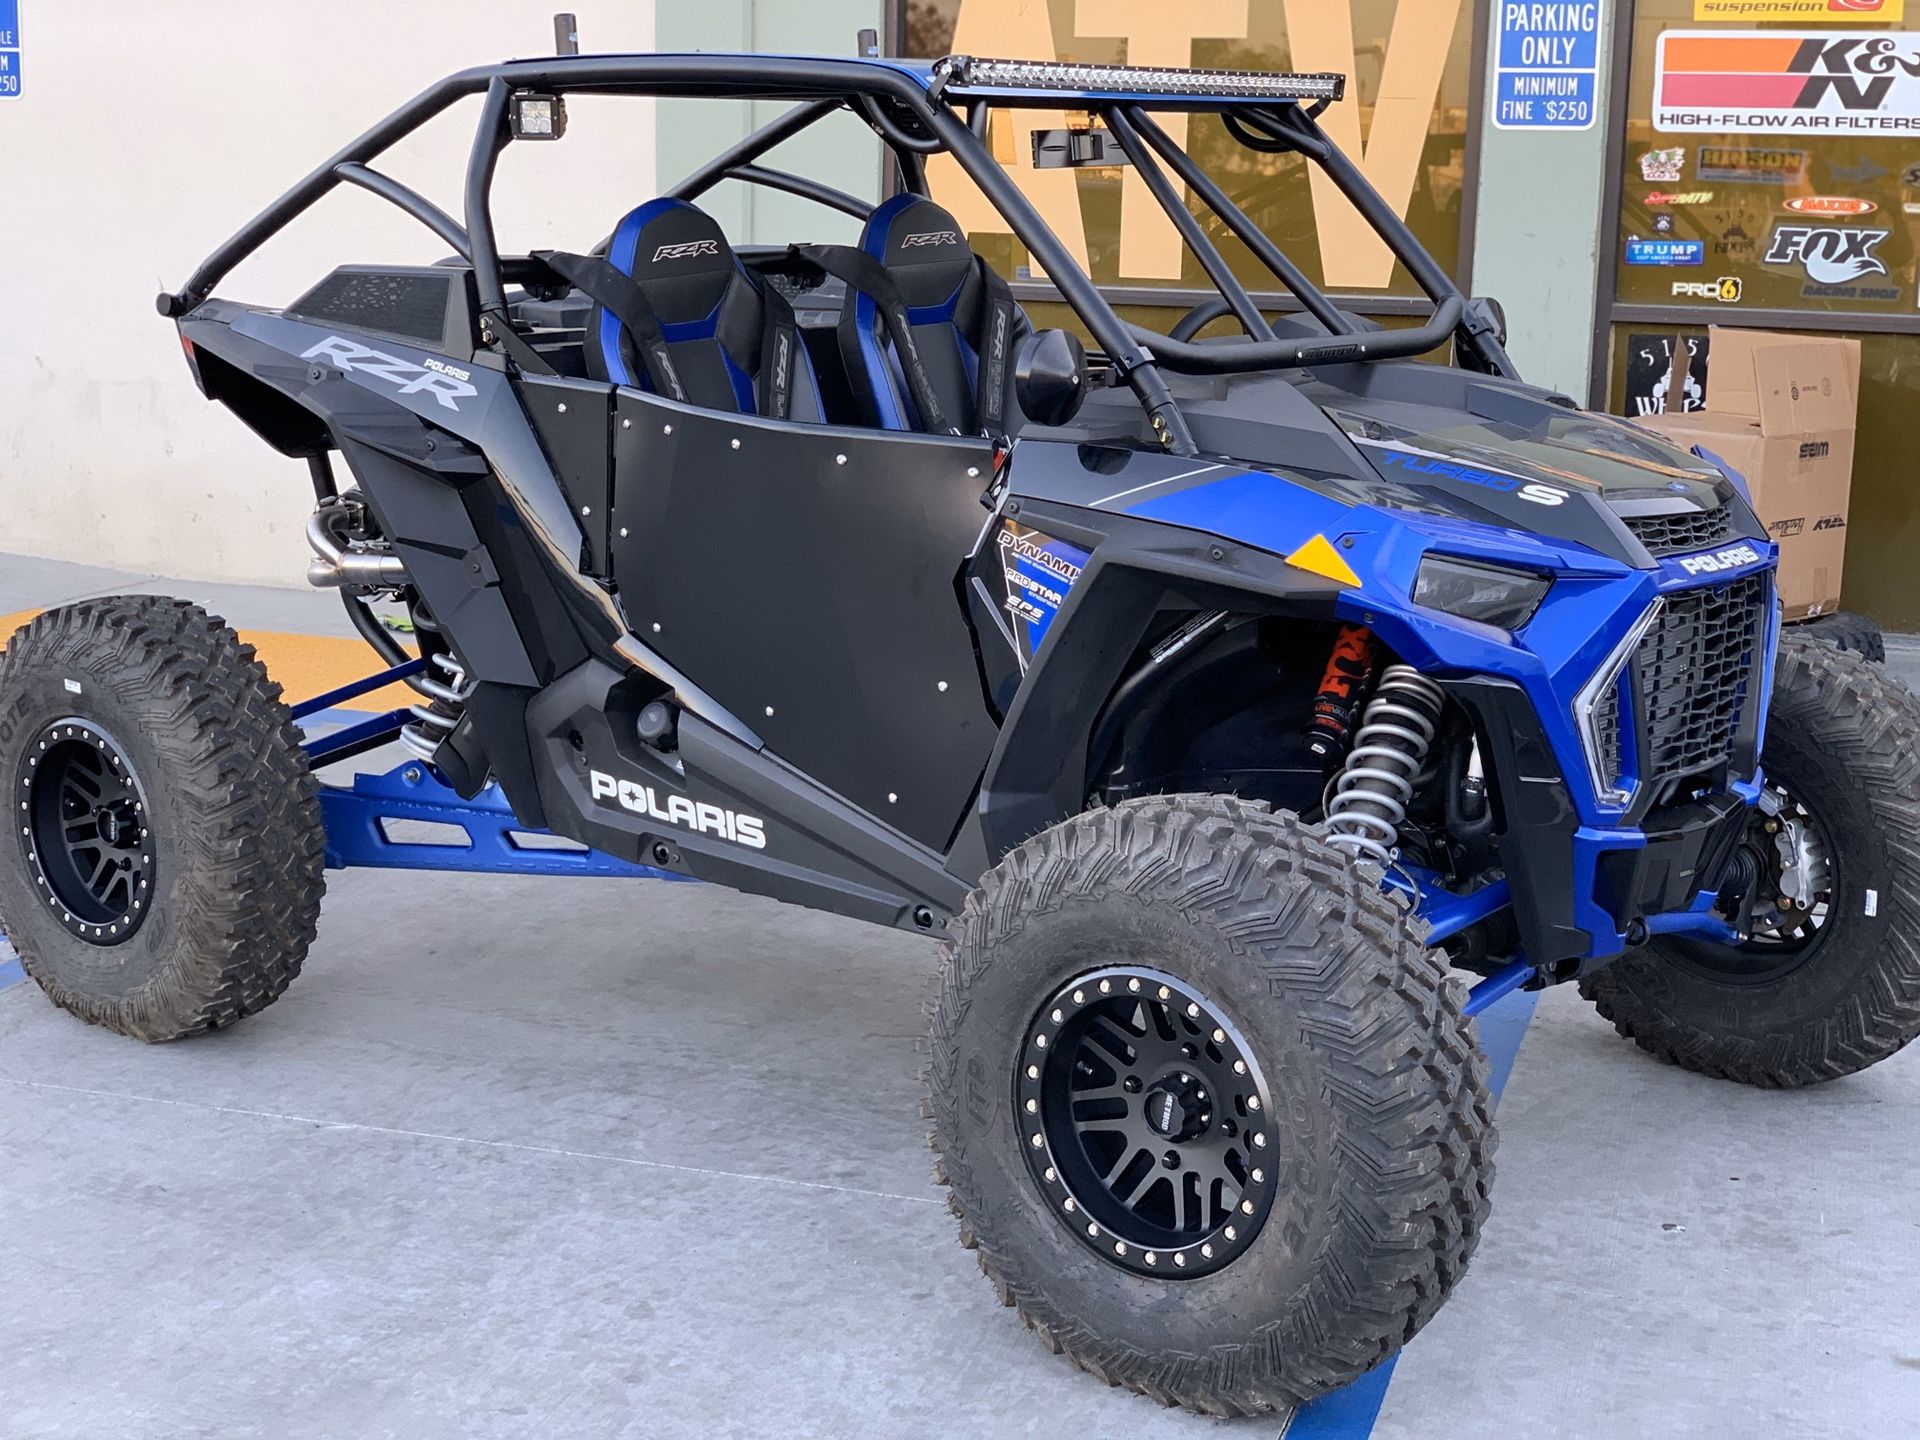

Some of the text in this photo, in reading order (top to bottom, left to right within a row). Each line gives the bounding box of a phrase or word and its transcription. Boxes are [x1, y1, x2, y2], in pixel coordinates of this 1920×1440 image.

[1505, 3, 1595, 32] PARKING
[1521, 36, 1577, 65] ONLY
[1514, 76, 1578, 96] MINIMUM
[1502, 100, 1588, 122] FINE $250
[1659, 113, 1920, 130] HIGH-FLOW AIR FILTERS
[1800, 198, 1862, 212] MAXXIS
[652, 239, 719, 263] RZR
[901, 231, 957, 249] RZR
[1631, 244, 1698, 255] TRUMP
[1764, 226, 1890, 264] FOX
[301, 335, 479, 412] RZR
[424, 358, 471, 382] POLARIS
[776, 333, 789, 390] RZR
[1383, 450, 1570, 506] TURBO S
[1679, 546, 1760, 577] POLARIS
[1006, 567, 1064, 605] PROSTAR
[1006, 594, 1045, 619] EPS
[590, 769, 767, 850] POLARIS
